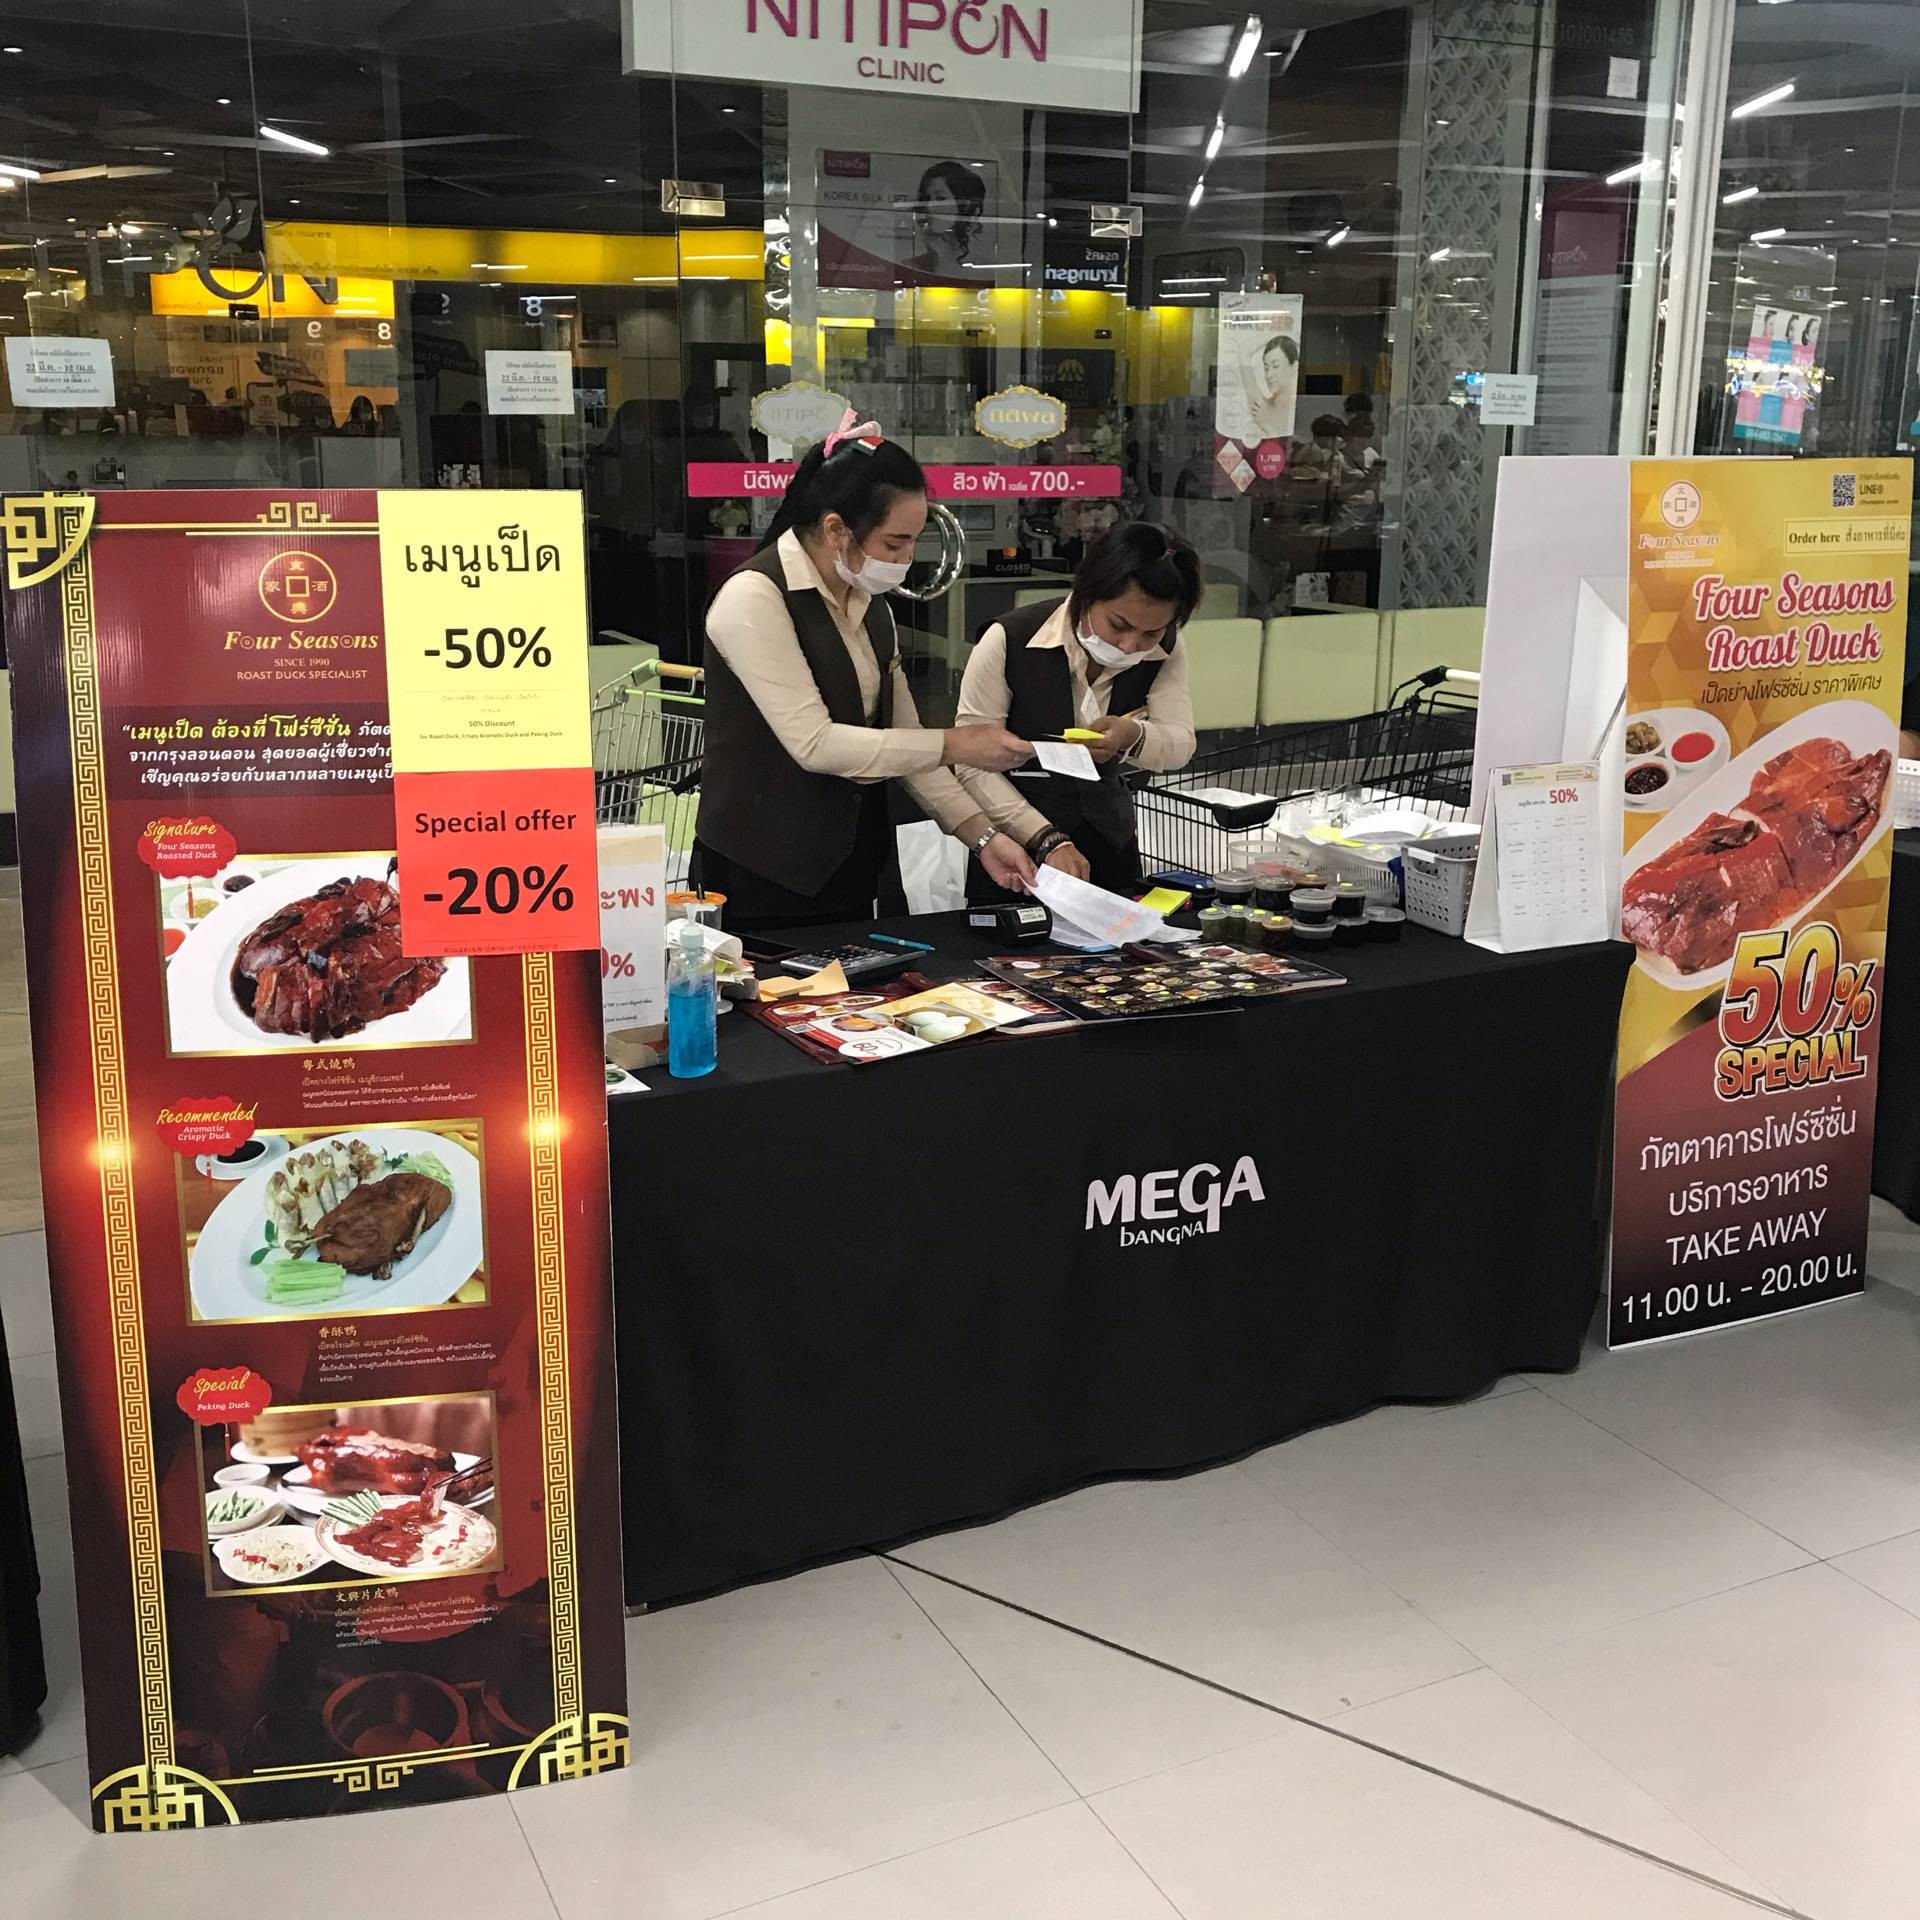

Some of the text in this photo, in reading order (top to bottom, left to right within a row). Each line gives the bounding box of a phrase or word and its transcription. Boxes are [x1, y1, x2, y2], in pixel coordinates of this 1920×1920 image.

[746, 0, 1048, 62] NITIPON
[857, 56, 945, 84] CLINIC
[824, 190, 858, 202] KOREA
[953, 472, 978, 491] สิว
[982, 471, 1006, 491] ฝ้า
[1030, 471, 1085, 491] 700.-
[1638, 532, 1720, 549] Four Seasons
[1789, 532, 1818, 544] Order
[1820, 532, 1840, 543] here
[405, 524, 561, 588] เมนูเป็ด
[1695, 573, 1895, 618] Four Seasons
[224, 630, 379, 651] Four Seasons
[424, 626, 552, 669] -50%
[1708, 622, 1881, 669] Roast Duck
[237, 669, 367, 681] ROAST DUCK SPECIALIST
[274, 657, 330, 668] SINCE 1990
[1701, 671, 1882, 704] เป็ดย่างโฟร์ซีซั่น ราคาพิเศษ
[122, 718, 203, 745] “เมนูเป็ด
[212, 713, 267, 739] ต้องที่
[268, 713, 351, 738] โฟร์ซีซั่น
[530, 731, 548, 739] Peking
[129, 750, 256, 766] จากกรุงลอนดอน
[1549, 788, 1578, 804] 50%
[144, 818, 217, 844] Signature
[415, 809, 577, 838] Special offer
[156, 850, 218, 860] Roasted Duck
[157, 841, 216, 850] Four Seasons
[424, 864, 574, 915] -20%
[601, 887, 655, 910] ะพง
[1721, 922, 1877, 1046] 50%
[1716, 1031, 1866, 1100] SPECIAL
[156, 1101, 258, 1125] Recommended
[177, 1131, 231, 1143] Crispy Duck
[183, 1124, 225, 1134] Aromatic
[1640, 1096, 1857, 1172] ภัตตาคารโฟร์ซีซั่น
[1085, 1155, 1266, 1233] MEGA
[1668, 1163, 1829, 1217] บริการอาหาร
[1666, 1208, 1828, 1267] TAKE AWAY
[1622, 1283, 1698, 1324] 11.00
[1707, 1278, 1732, 1307] น.
[1761, 1255, 1829, 1297] 20.00
[1836, 1253, 1858, 1279] น.
[193, 1370, 251, 1400] Special
[197, 1401, 250, 1412] Peking Duck
